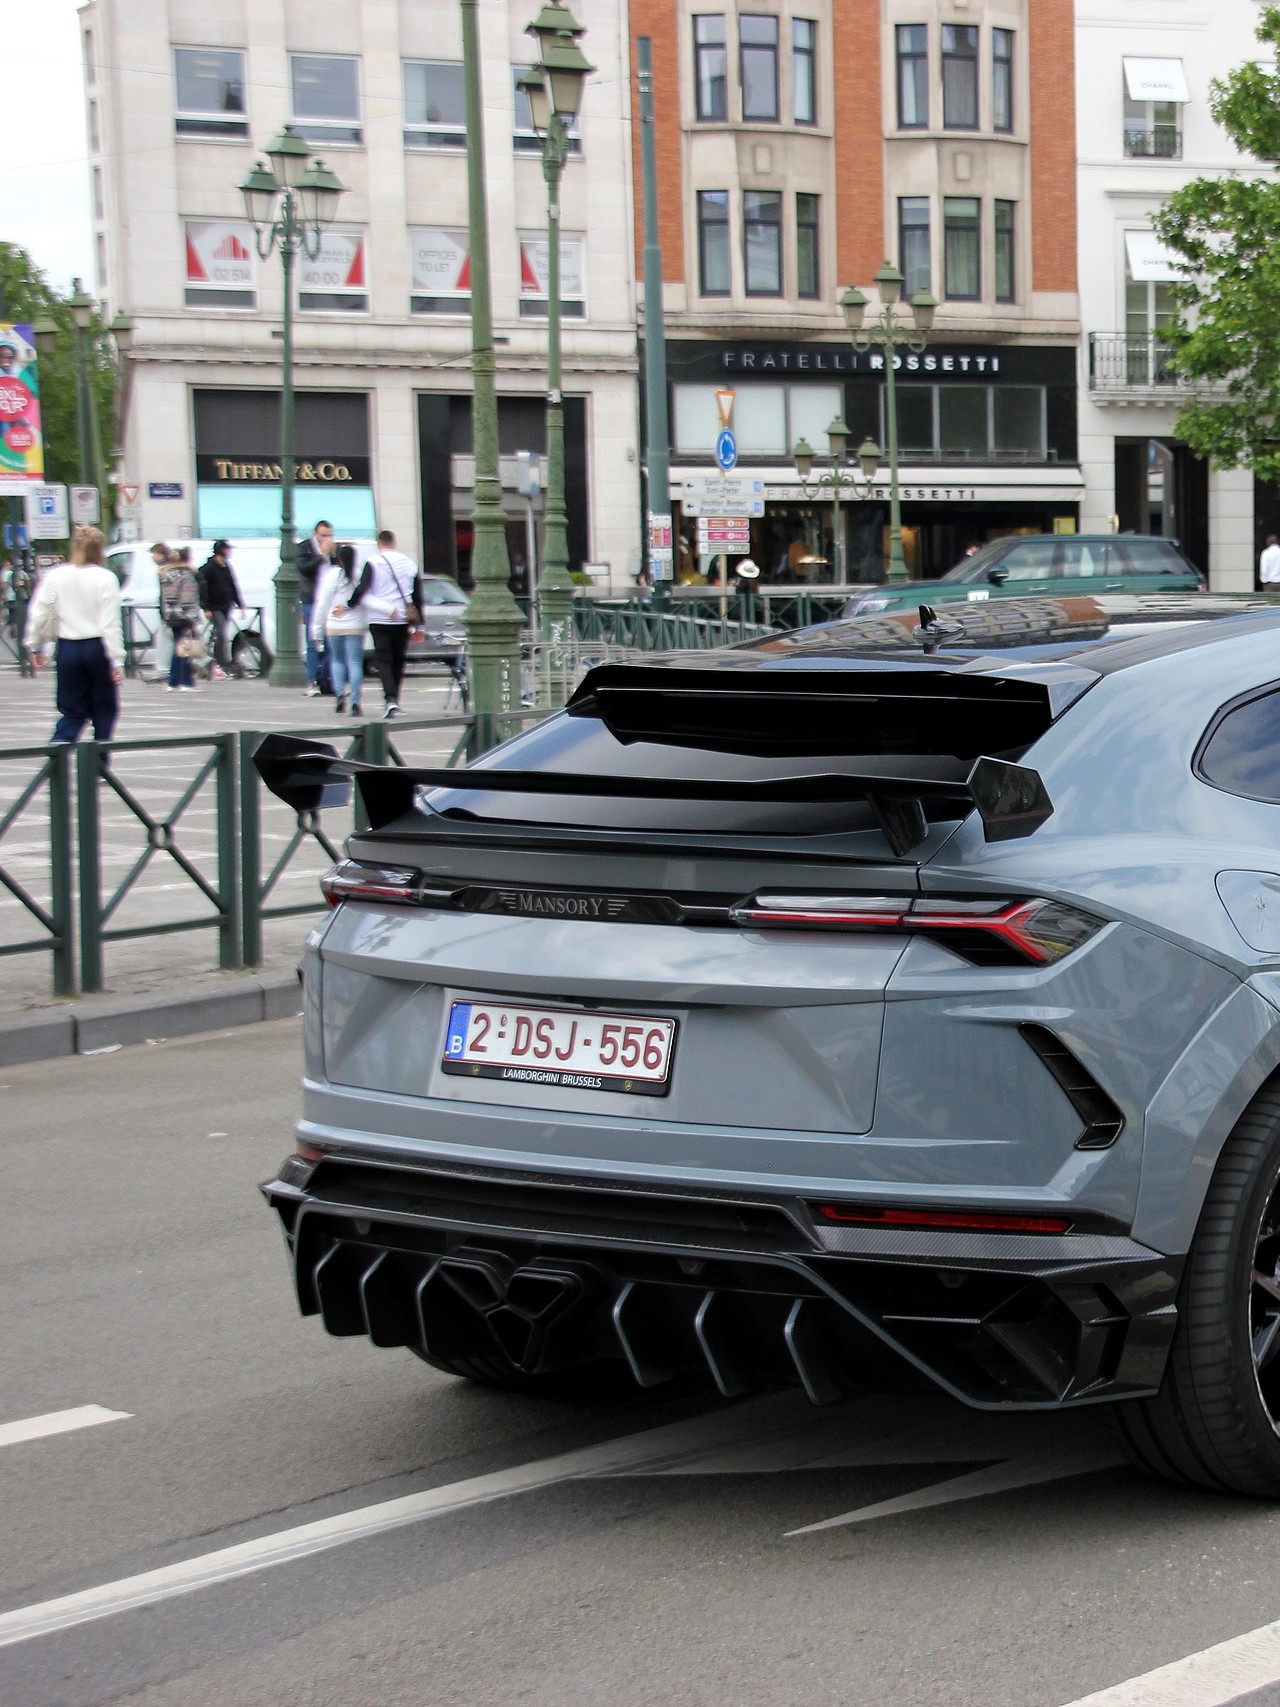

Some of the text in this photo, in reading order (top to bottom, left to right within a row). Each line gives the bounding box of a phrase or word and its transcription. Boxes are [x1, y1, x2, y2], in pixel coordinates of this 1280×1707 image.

[418, 250, 457, 261] OFFICES
[420, 262, 450, 273] TO LET
[304, 271, 340, 285] 40 00
[723, 353, 999, 372] FRATELLI ROSSETTI
[767, 489, 975, 500] FRATELL RSSETTI
[519, 893, 604, 916] MANSORY
[451, 1035, 463, 1054] B
[503, 1067, 602, 1088] LAMBORGHINI BRUSSELS
